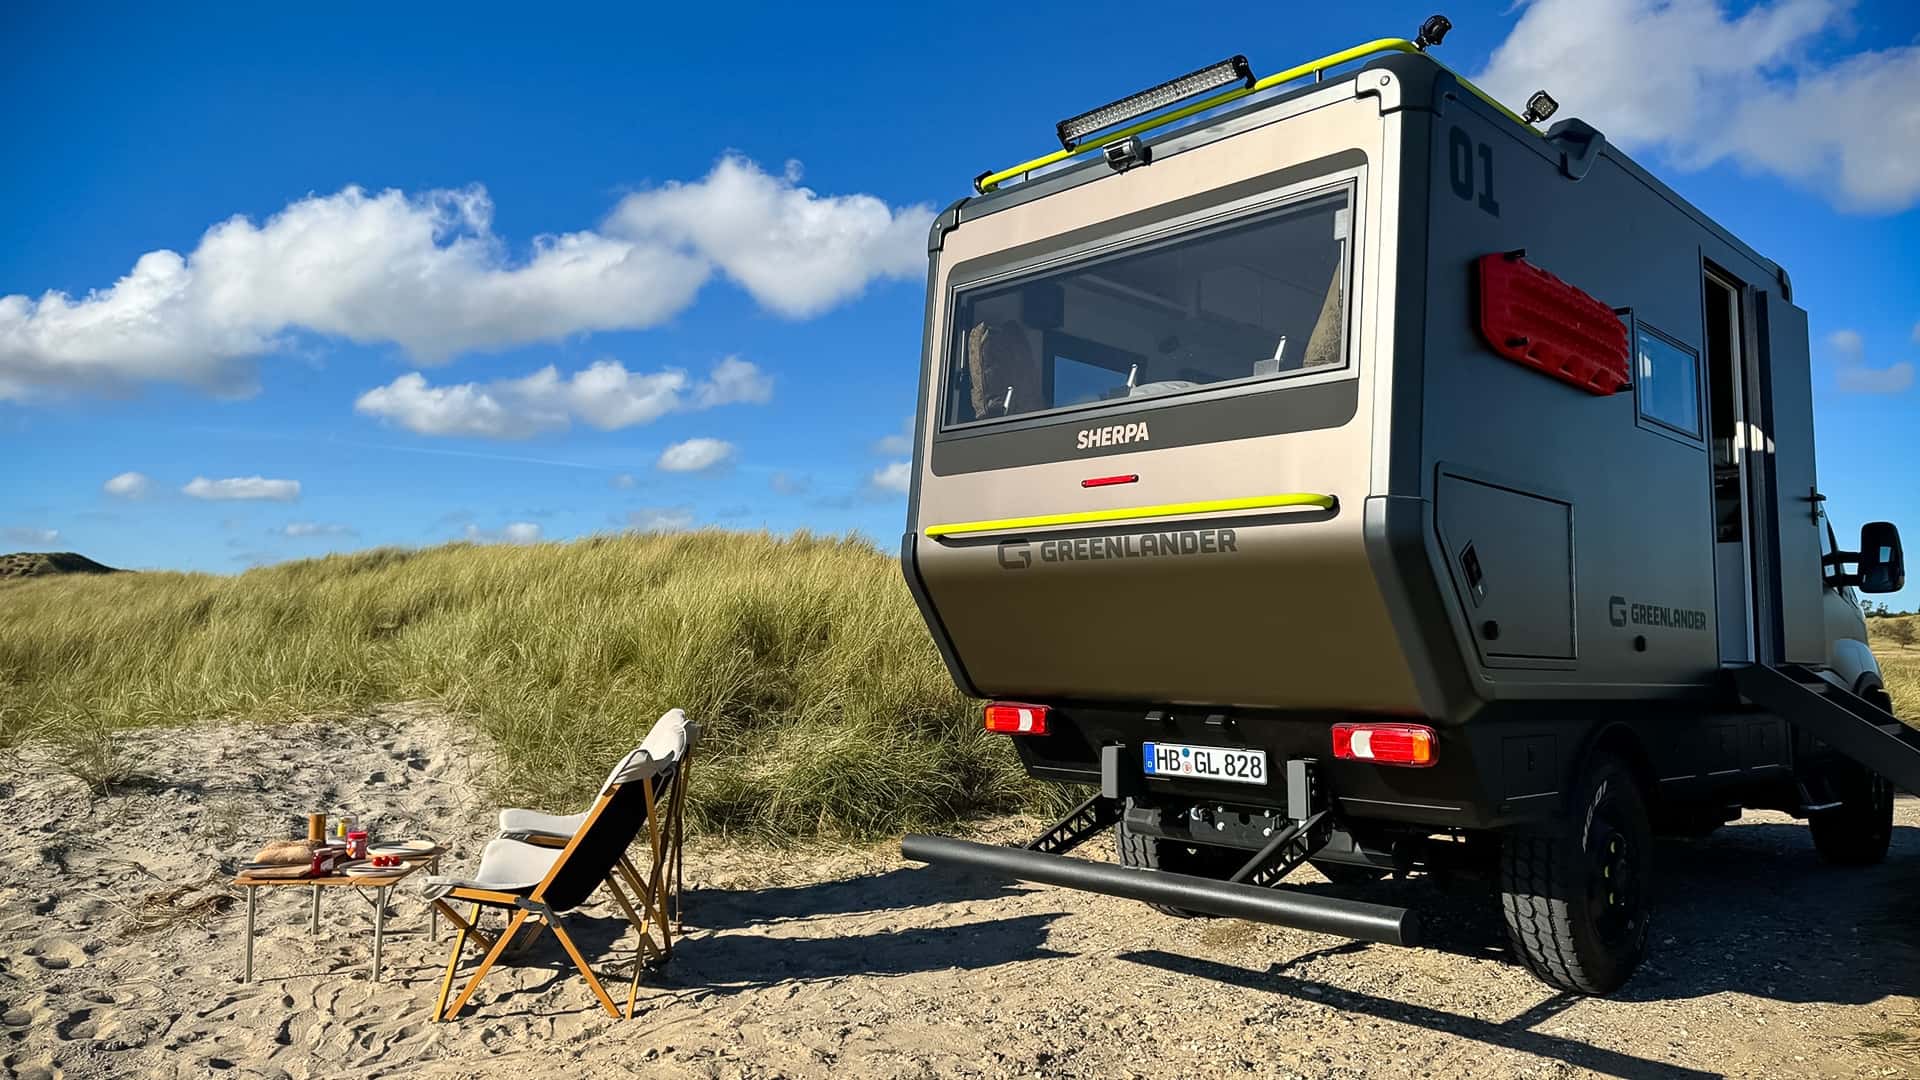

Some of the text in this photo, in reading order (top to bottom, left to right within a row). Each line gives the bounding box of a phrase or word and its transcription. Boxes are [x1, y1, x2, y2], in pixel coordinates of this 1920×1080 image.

[1450, 125, 1499, 219] 01
[1077, 421, 1150, 450] SHERPA
[1040, 528, 1238, 563] GREENLANDER
[1631, 603, 1707, 631] GREENLANDER
[1156, 748, 1262, 779] HB GL 828
